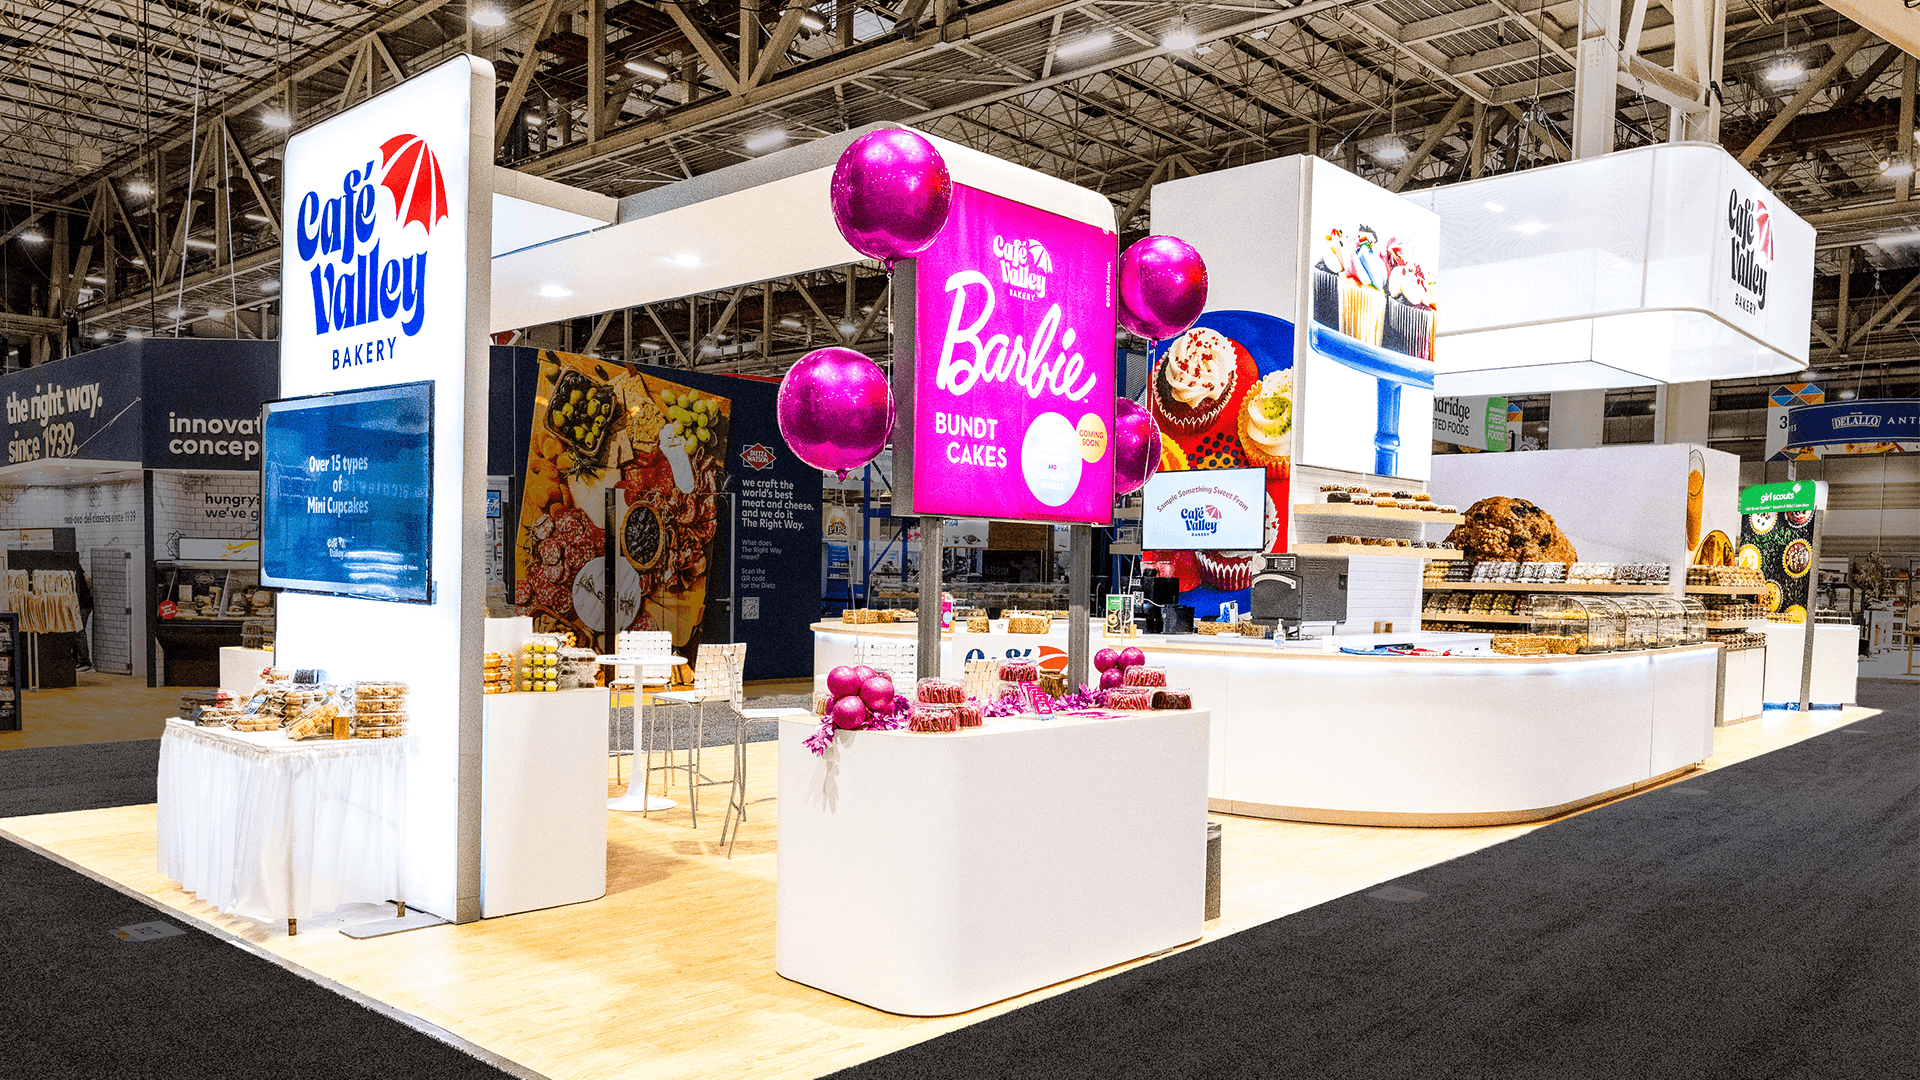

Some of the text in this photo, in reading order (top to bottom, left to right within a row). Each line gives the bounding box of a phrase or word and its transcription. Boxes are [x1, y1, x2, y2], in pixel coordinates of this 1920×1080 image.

[297, 160, 376, 263] Café
[1729, 188, 1754, 250] Café
[993, 235, 1027, 267] Café
[1000, 259, 1046, 298] Valley
[1731, 236, 1767, 310] Valley
[310, 237, 427, 336] Valley
[1009, 288, 1035, 301] BAKERY
[1735, 292, 1757, 316] BAKERY
[936, 270, 1097, 401] Barbie
[332, 336, 397, 370] BAKERY
[6, 382, 103, 427] the right way.
[935, 411, 998, 440] BUNDT
[1447, 421, 1469, 436] FOODS
[1834, 416, 1879, 428] DELALLO
[8, 421, 78, 463] since 1939.
[1078, 429, 1104, 439] COMING
[1487, 429, 1505, 441] FOODS
[169, 439, 260, 461] concep
[946, 442, 1007, 468] CAKES
[309, 454, 369, 475] Over 15 types
[332, 474, 343, 492] of
[756, 479, 778, 489] craft
[779, 480, 794, 490] the
[742, 488, 794, 500] world's best
[1156, 485, 1249, 513] Sample Something Sweet From
[1760, 492, 1795, 504] girl scouts
[205, 507, 247, 519] we've
[307, 496, 369, 518] Mini Cupcakes
[741, 500, 815, 511] meat and cheese.
[741, 508, 794, 519] and we do it
[1180, 506, 1205, 521] Café
[92, 511, 111, 523] classics
[111, 511, 124, 523] since
[124, 510, 136, 522] 1939
[741, 518, 805, 532] The Right Way.
[828, 526, 847, 535] PIES
[1184, 519, 1218, 534] Valley
[753, 546, 769, 554] Right
